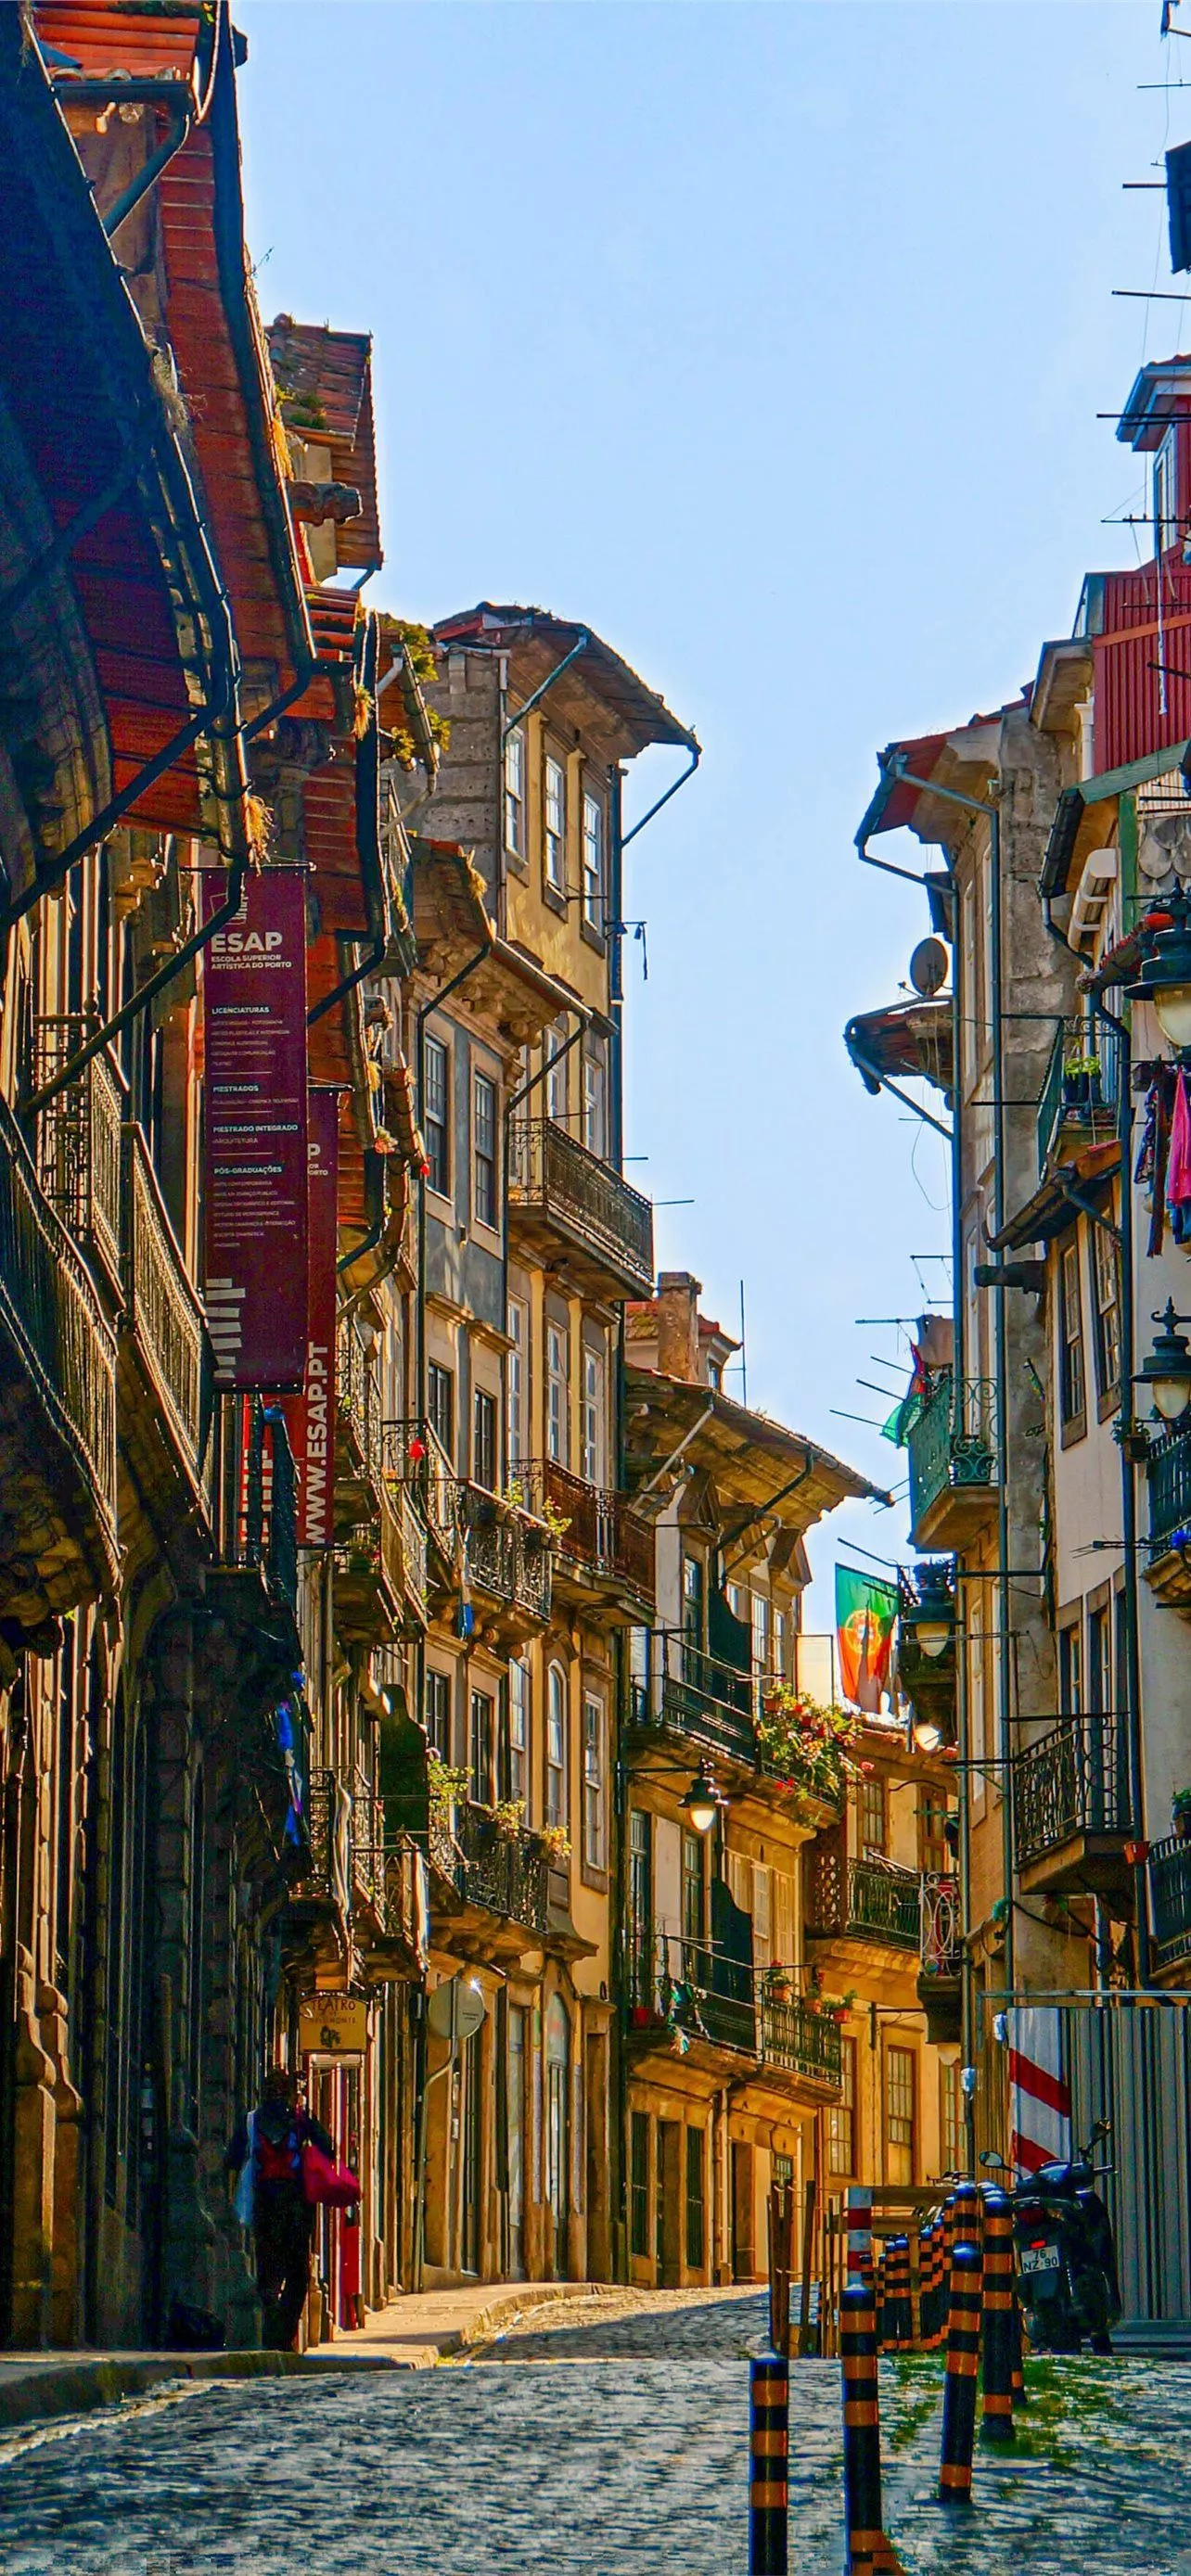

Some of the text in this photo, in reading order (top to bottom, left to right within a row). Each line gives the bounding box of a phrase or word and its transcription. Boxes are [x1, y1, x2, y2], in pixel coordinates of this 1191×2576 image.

[211, 932, 282, 952] ESAP
[211, 1006, 270, 1014] LICENCIATURAS
[214, 1165, 282, 1175] PÓS-GRADUAÇÕES
[305, 1341, 328, 1545] WWW.ESAP.PT
[312, 1996, 356, 2010] TEATRO
[1033, 2249, 1046, 2260] 76
[1024, 2256, 1057, 2271] NZ 90
